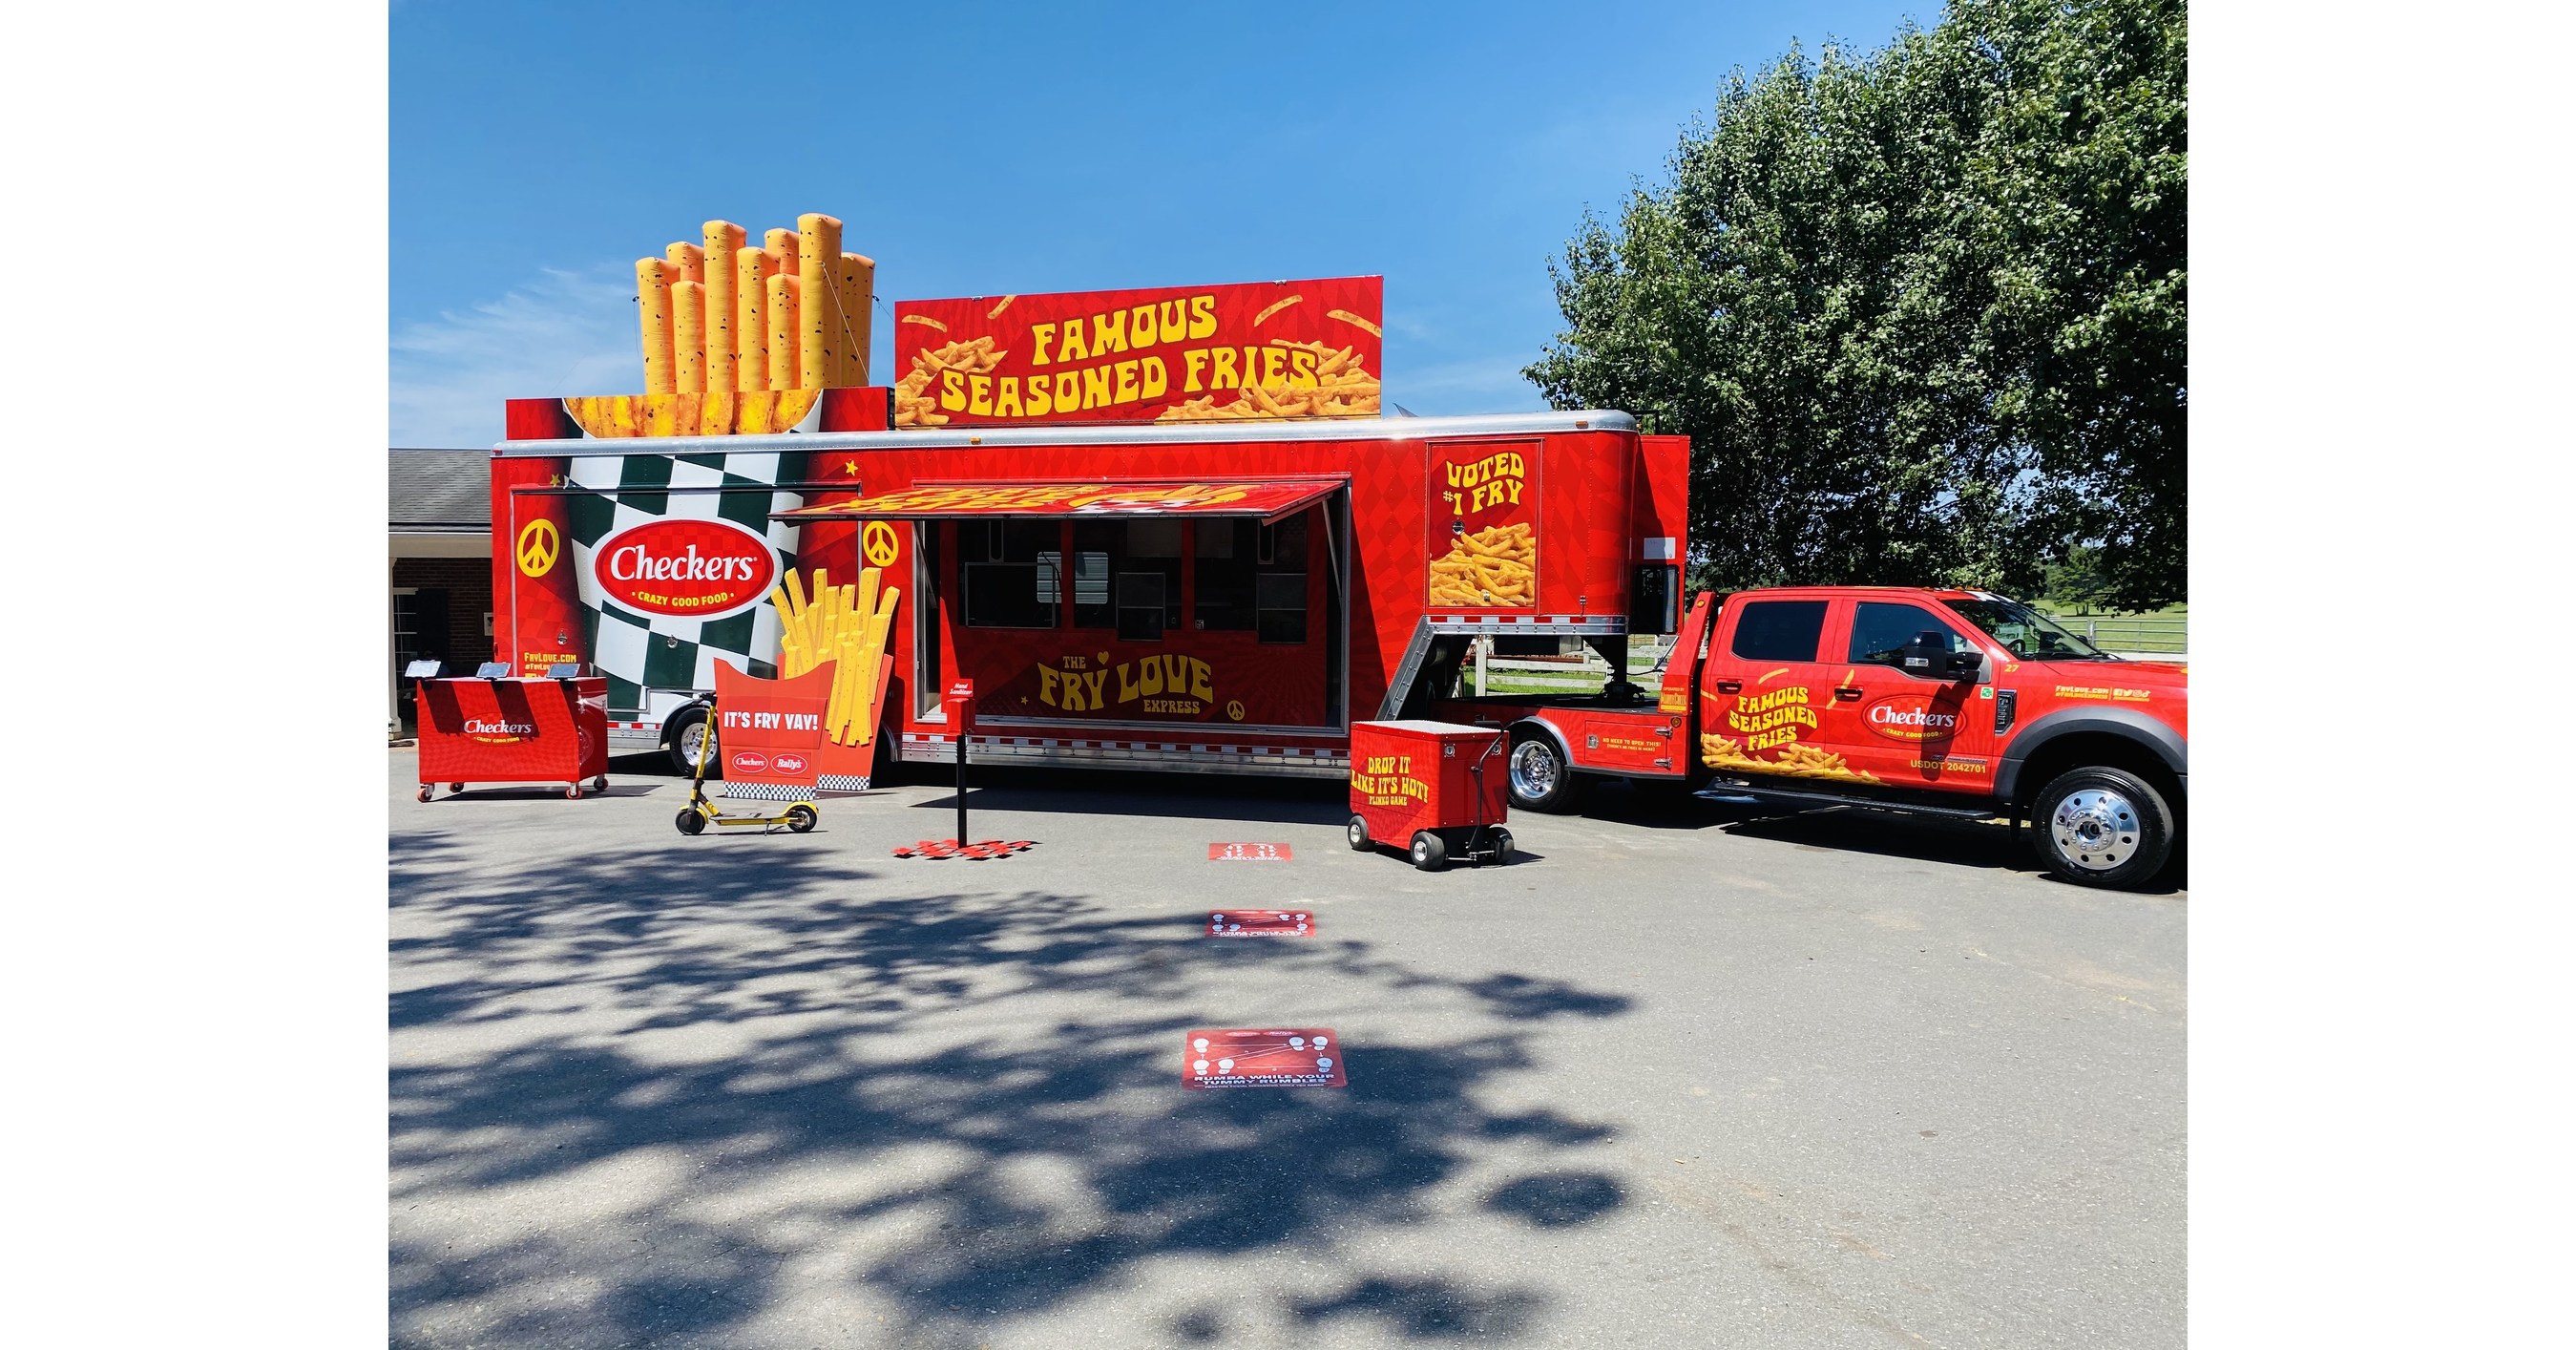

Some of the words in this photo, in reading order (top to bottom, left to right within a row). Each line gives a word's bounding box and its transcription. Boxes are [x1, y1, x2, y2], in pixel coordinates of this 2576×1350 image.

[1032, 295, 1217, 365] FAMOUS
[941, 355, 1167, 417] SEASONED
[1183, 344, 1319, 392] FRIES
[1446, 453, 1525, 488] VOTED
[1443, 491, 1463, 515] #1
[1472, 479, 1524, 513] FRY
[610, 543, 754, 581] Checkers
[638, 591, 668, 605] CRAZY
[671, 597, 700, 607] GOOD
[702, 592, 728, 605] FOOD
[1062, 656, 1086, 669] THE
[2004, 664, 2020, 673] 27
[1037, 663, 1108, 711] FRY
[1116, 654, 1213, 704] LOVE
[1143, 699, 1201, 714] EXPRESS
[1738, 686, 1809, 713] FAMOUS
[464, 719, 532, 733] Checkers
[723, 711, 751, 728] IT'S
[754, 712, 781, 729] FRY
[785, 713, 819, 730] YAY!
[1729, 706, 1817, 732] SEASONED
[1871, 706, 1955, 727] Checkers
[1748, 726, 1797, 751] FRIES
[1886, 728, 1904, 737] CRAZY
[735, 757, 764, 767] Checkers
[777, 758, 803, 770] Rally's
[1368, 756, 1395, 774] DROP
[1398, 756, 1411, 774] IT
[1910, 760, 1945, 770] USDOT
[1947, 762, 1986, 773] 2042701
[1351, 769, 1375, 794] LIKE
[1377, 776, 1398, 794] IT'S
[1401, 777, 1429, 804] HOT!
[1369, 795, 1390, 806] PLINKO
[1390, 796, 1407, 806] GAME
